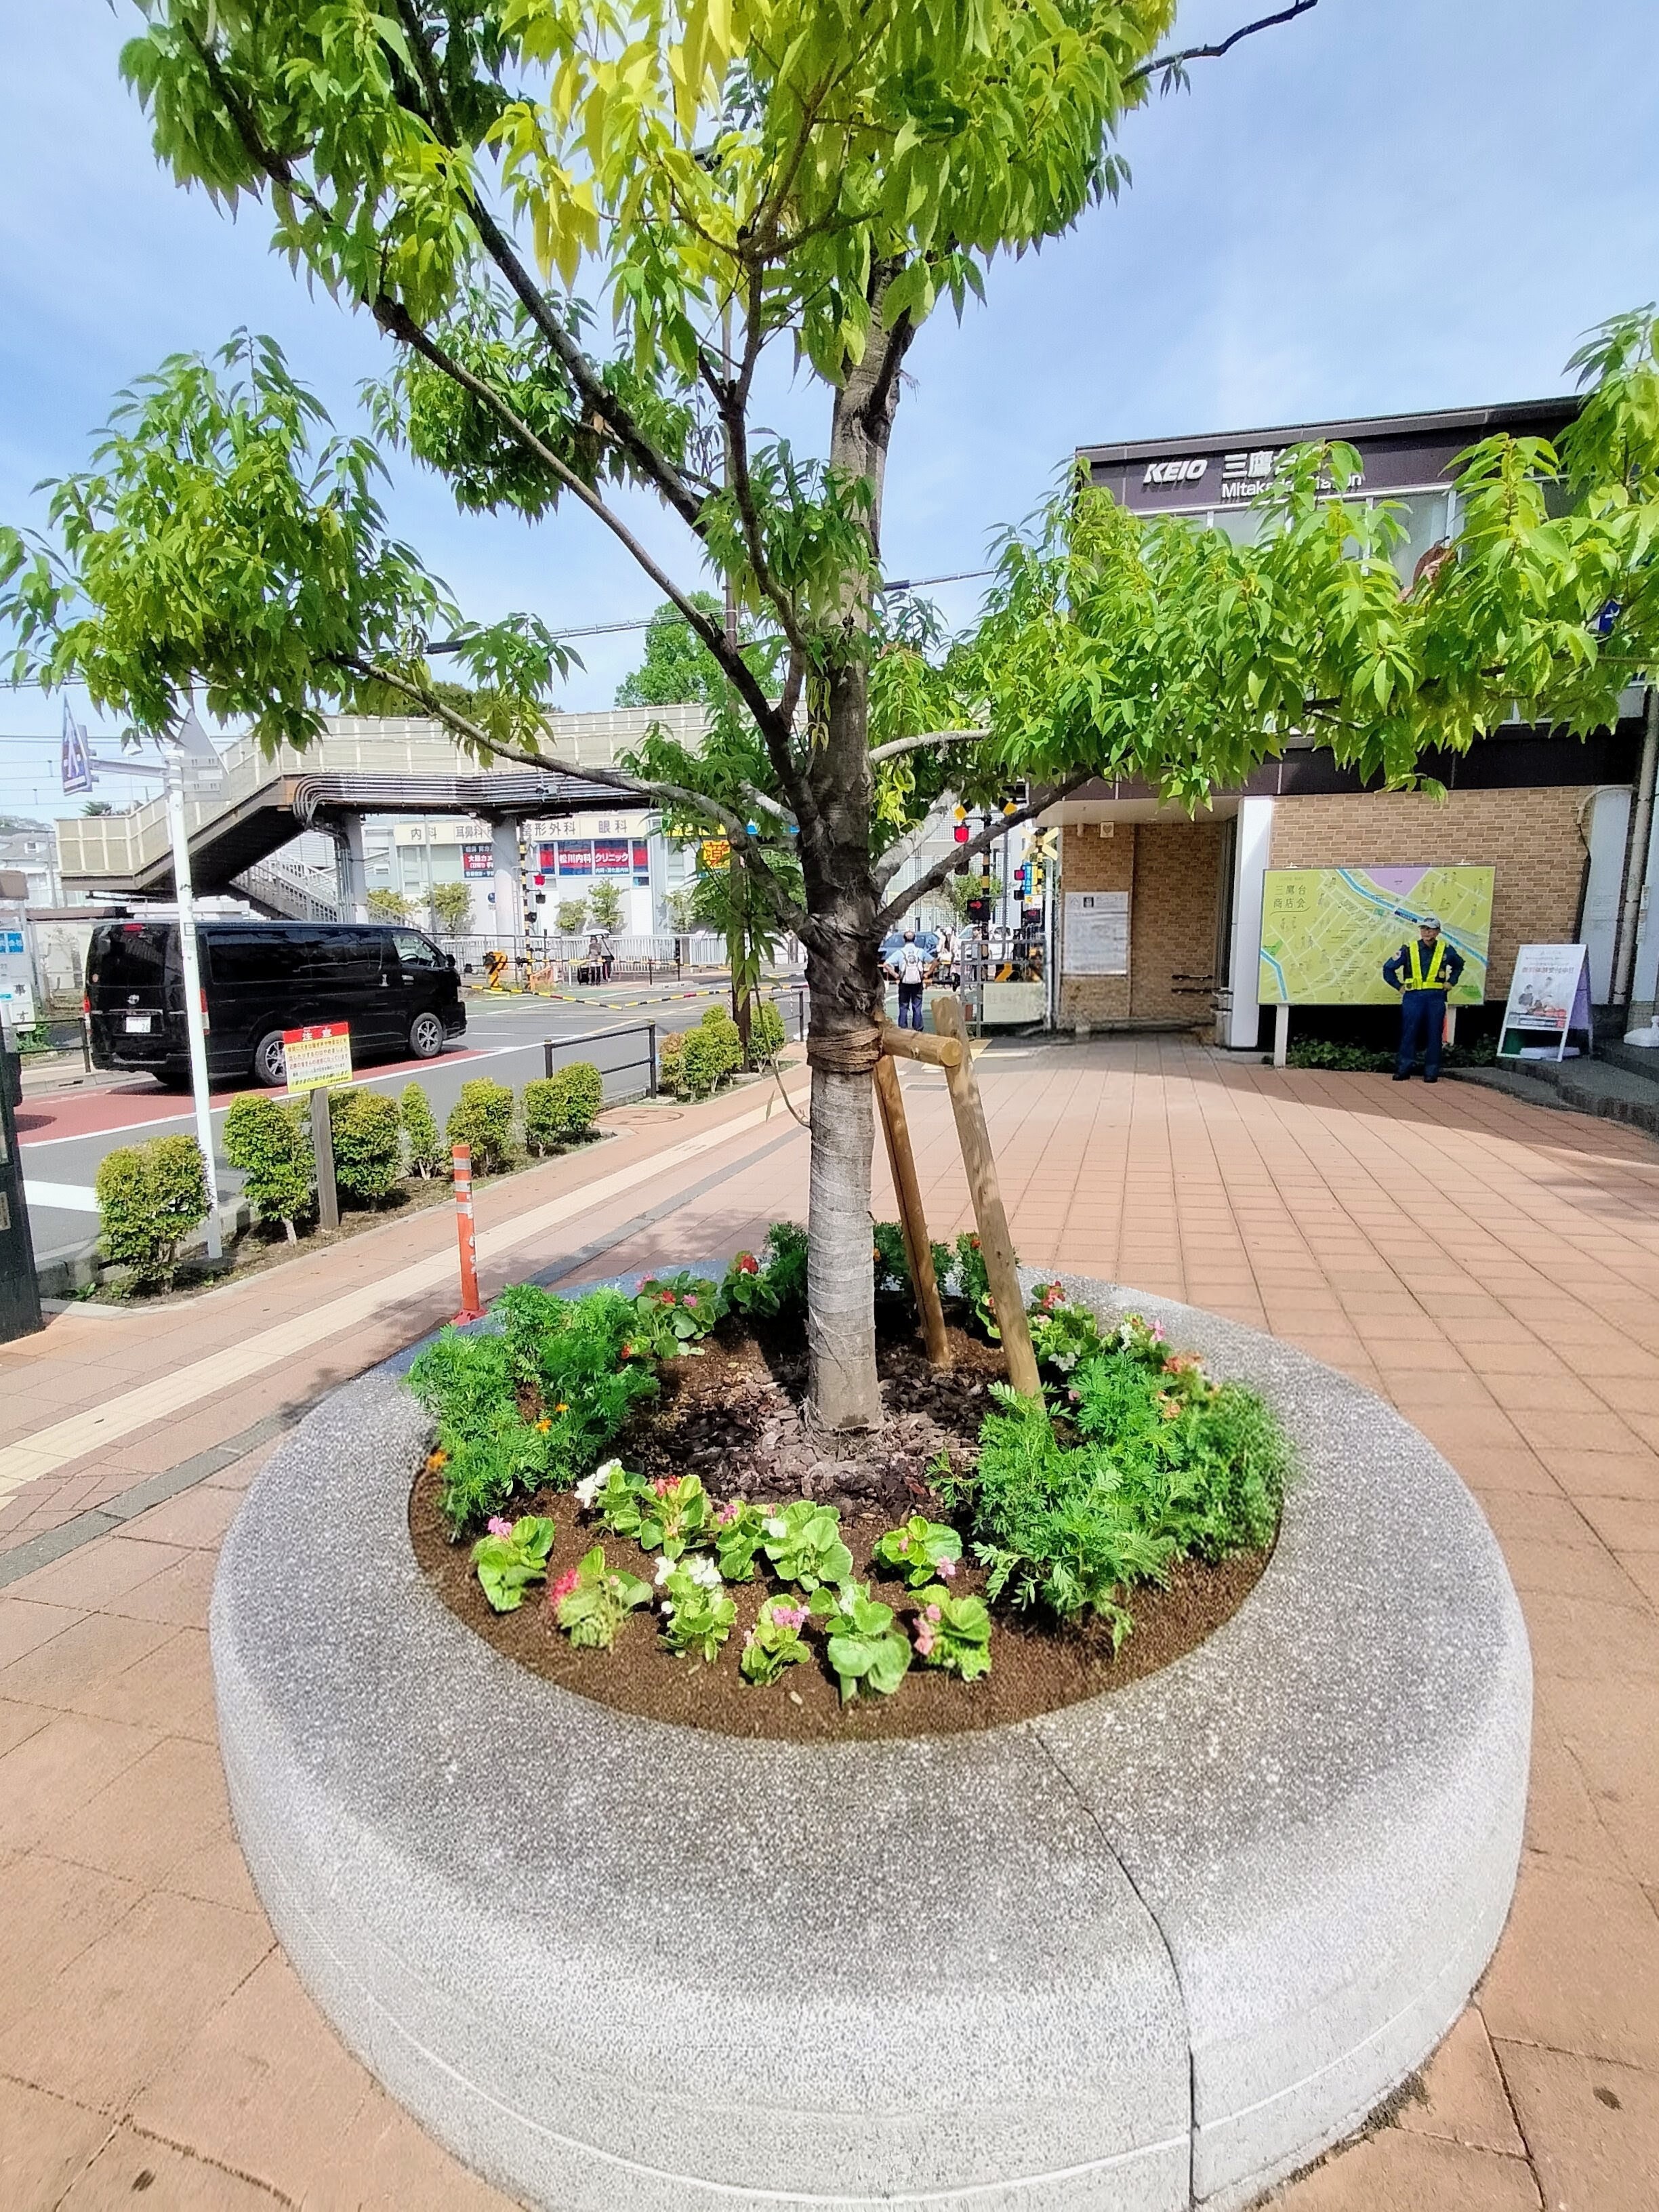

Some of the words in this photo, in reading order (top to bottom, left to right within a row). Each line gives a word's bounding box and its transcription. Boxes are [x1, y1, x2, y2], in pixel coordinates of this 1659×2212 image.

[1143, 459, 1208, 483] KEIO
[598, 820, 628, 834] 眼科
[596, 851, 629, 863] クリニック
[1275, 884, 1307, 896] 三鷹台
[1273, 897, 1306, 909] 商店会
